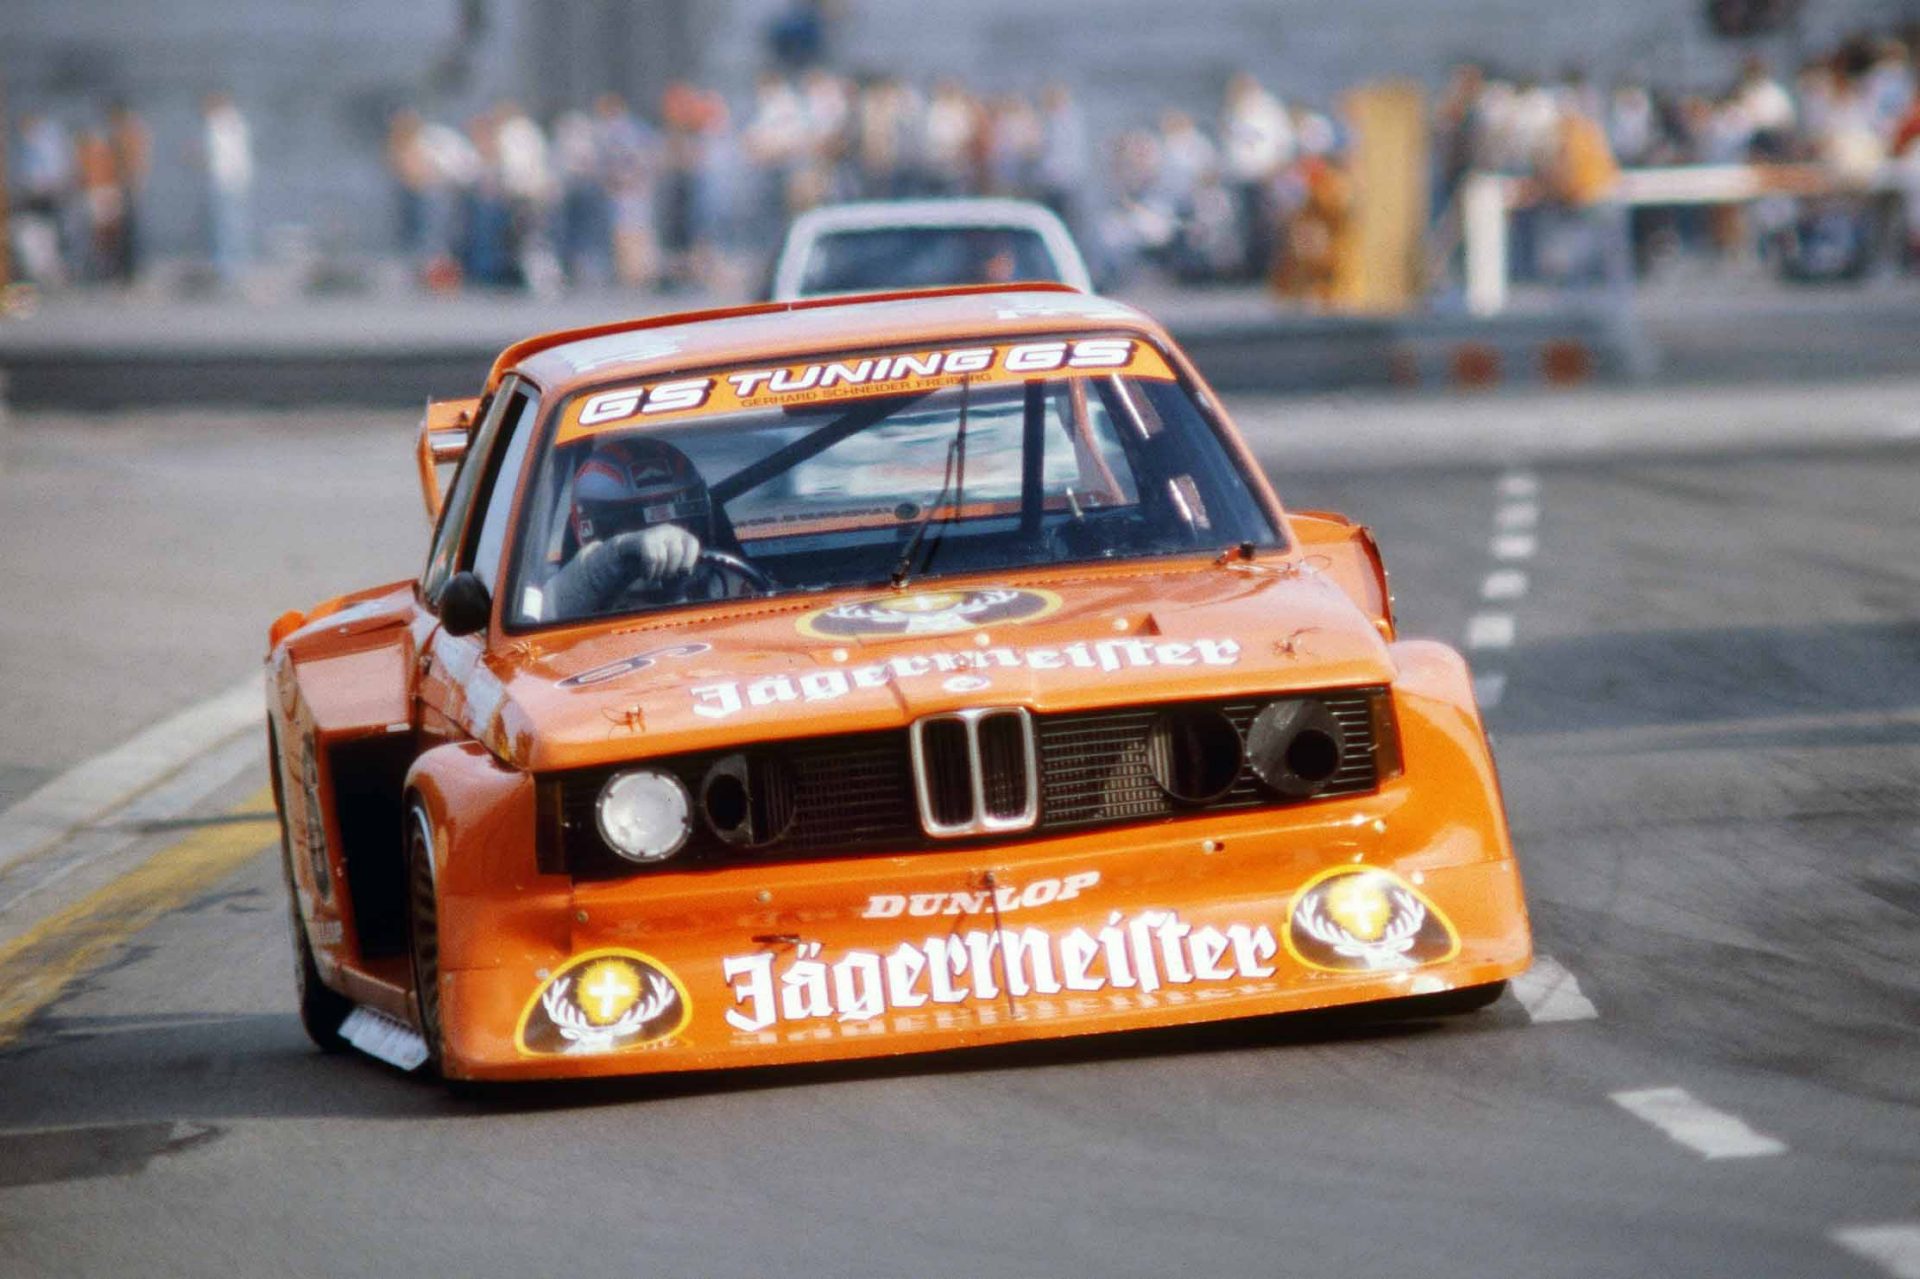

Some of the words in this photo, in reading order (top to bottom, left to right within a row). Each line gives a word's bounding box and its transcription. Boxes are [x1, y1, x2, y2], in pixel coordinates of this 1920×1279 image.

[578, 378, 716, 426] GS
[728, 348, 997, 397] TUNING
[1004, 339, 1138, 373] GS
[741, 391, 817, 408] GERHARD
[822, 381, 911, 399] SCHNEIDER
[690, 638, 1241, 718] Jägermeister
[861, 871, 1100, 918] DUNLOP
[722, 909, 1278, 1032] Jägermeister
